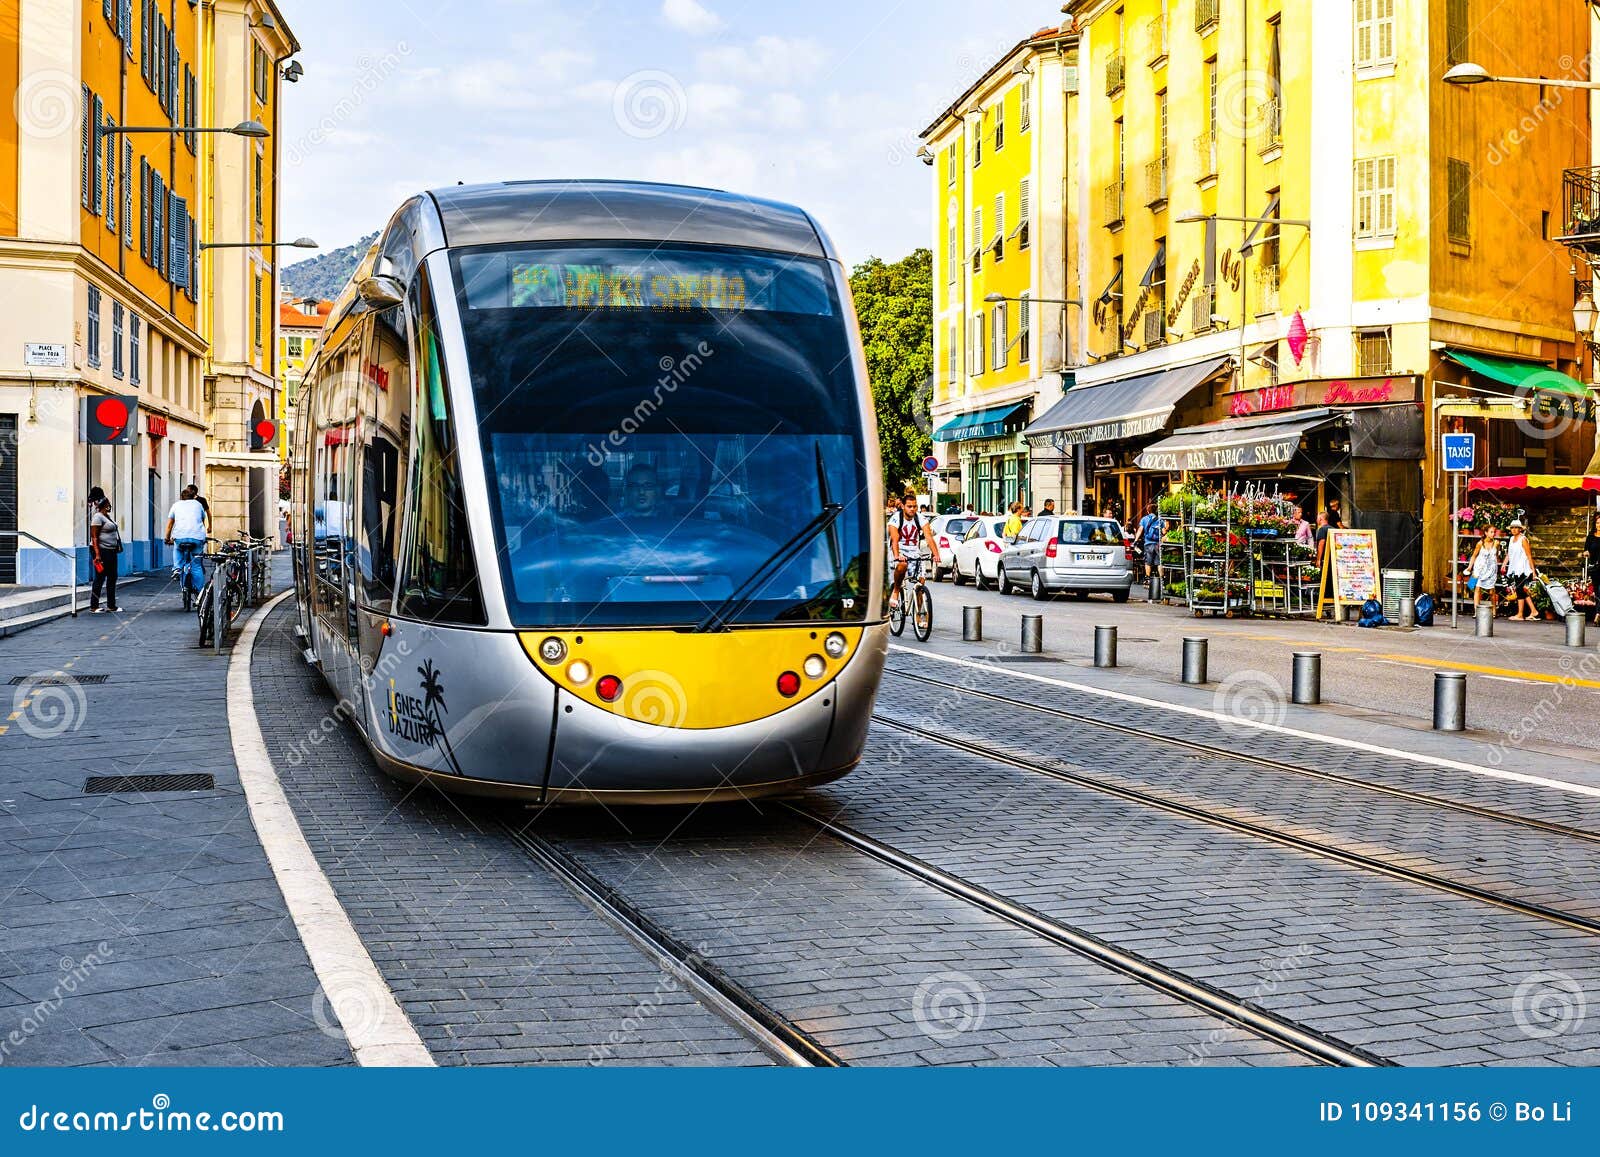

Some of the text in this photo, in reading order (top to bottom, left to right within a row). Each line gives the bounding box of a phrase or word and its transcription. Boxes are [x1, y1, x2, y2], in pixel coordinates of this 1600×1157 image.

[1142, 441, 1291, 470] SOCCA BAR TABAC SNACK
[1447, 446, 1471, 458] TAXIS
[841, 598, 855, 609] 19
